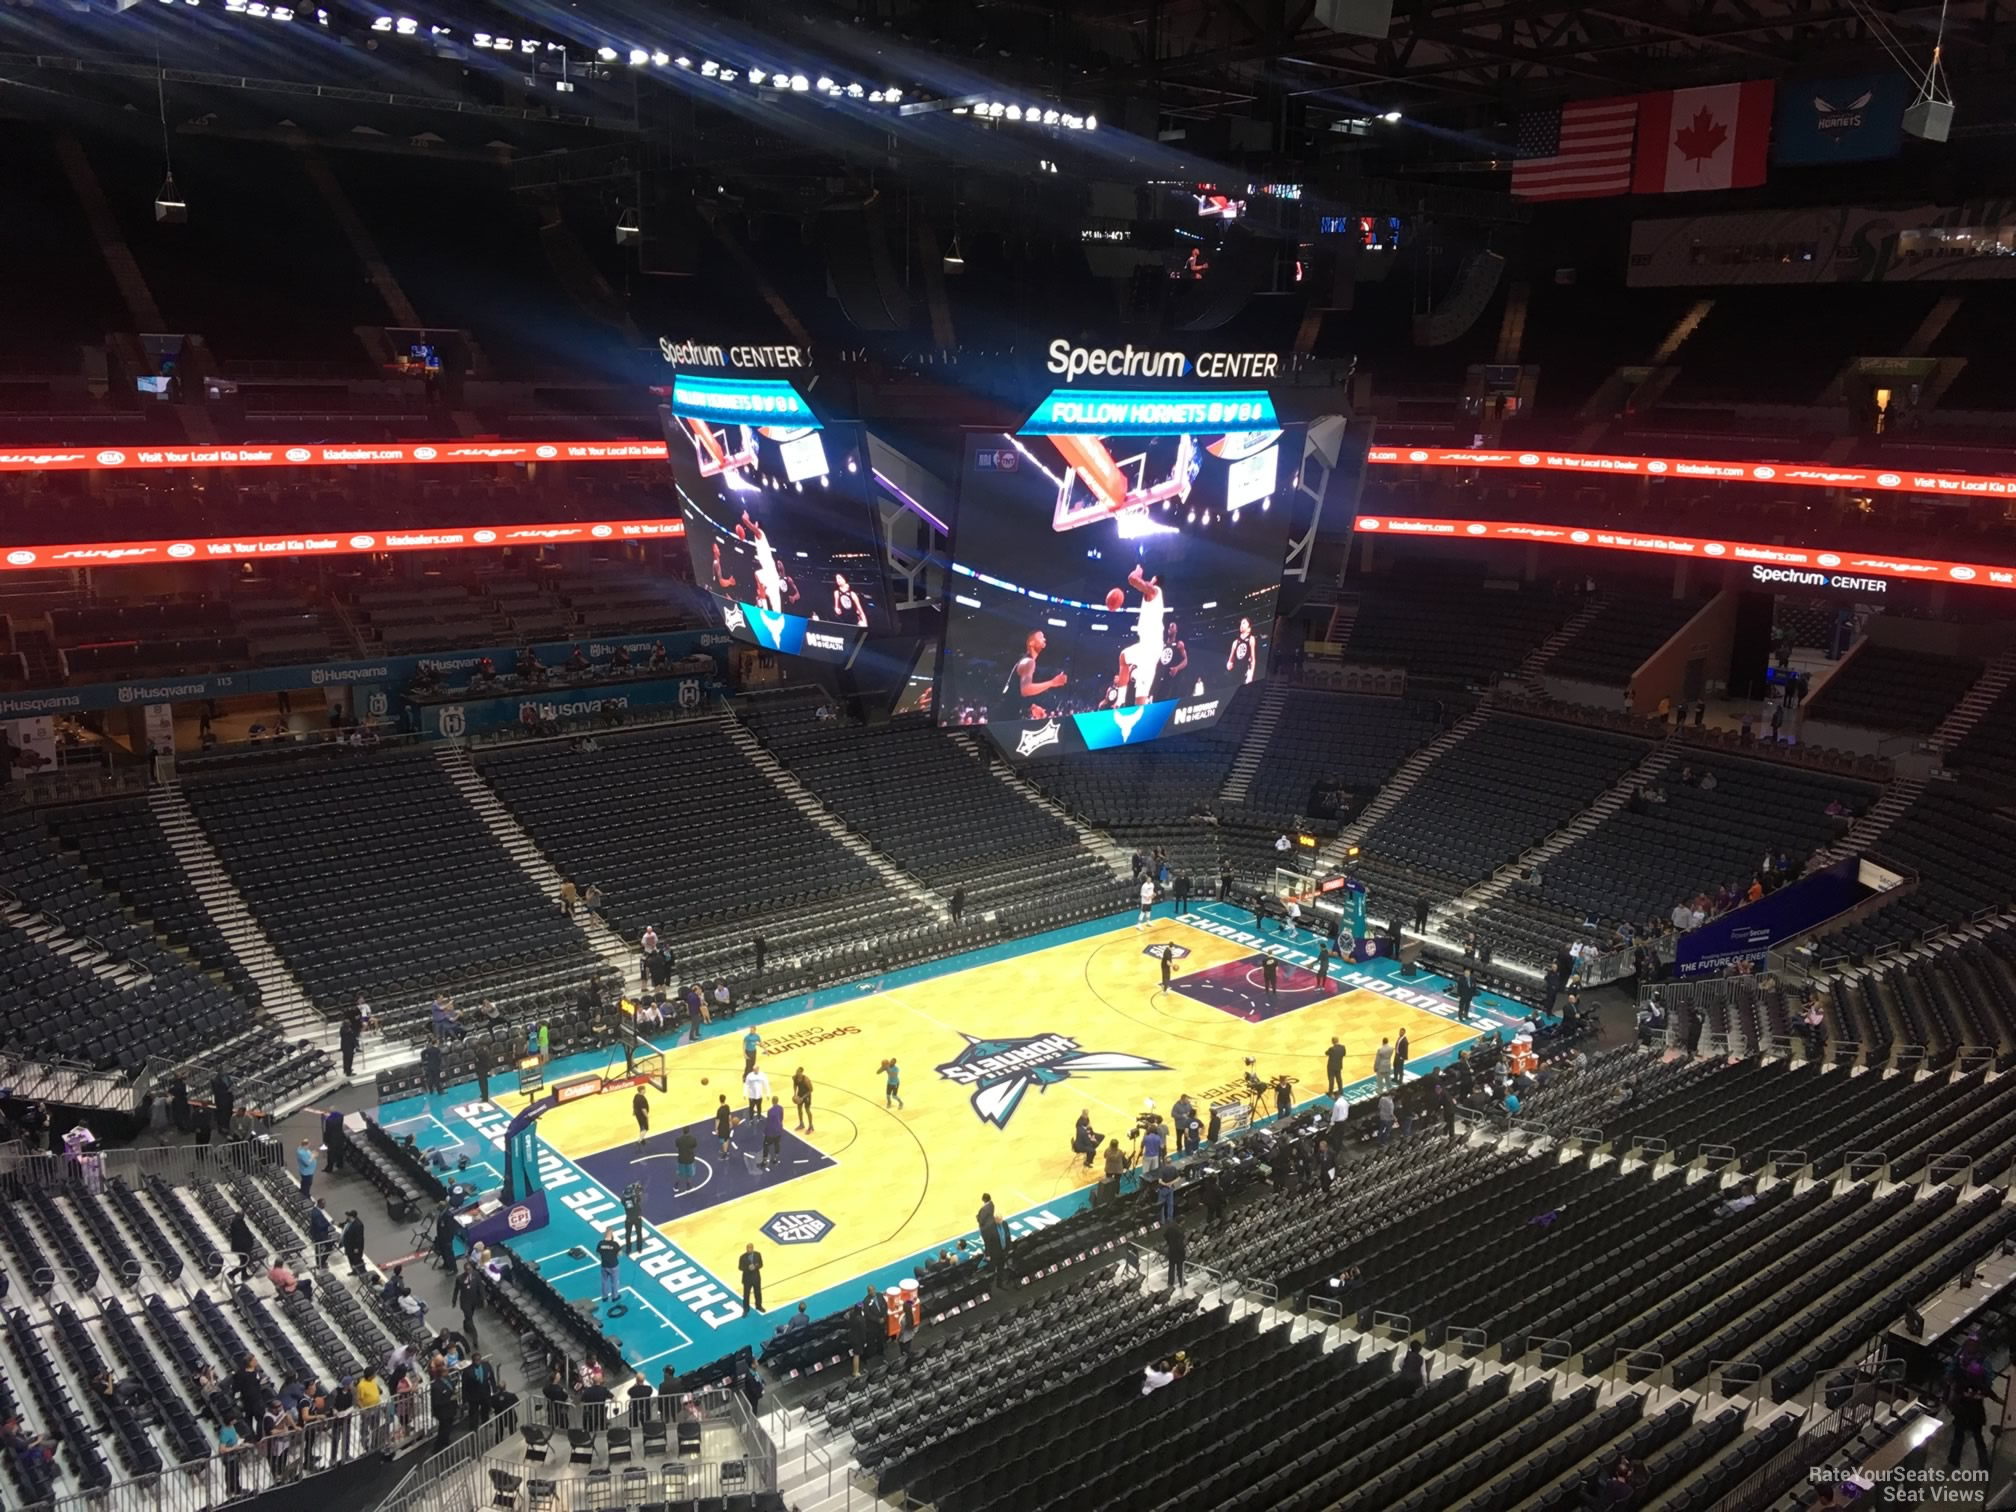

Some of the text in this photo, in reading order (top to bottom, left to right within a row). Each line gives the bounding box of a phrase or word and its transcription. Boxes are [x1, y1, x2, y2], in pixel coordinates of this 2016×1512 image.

[1817, 114, 1862, 130] HORNETS
[659, 337, 803, 368] Spectrum CENTER
[1047, 339, 1278, 382] Spectrum CENTER
[1052, 402, 1206, 423] FOLLOW HORNETS
[138, 449, 272, 463] Visit Your Local Kia Dealer
[568, 447, 587, 456] Visit
[588, 447, 606, 456] Your
[607, 446, 628, 455] Local
[1914, 478, 1937, 489] Visit
[1937, 479, 1960, 490] Your
[1961, 480, 1988, 492] Local
[1989, 482, 2006, 493] Kia
[207, 544, 232, 555] Visit
[233, 542, 258, 553] Your
[259, 540, 286, 552] Local
[1752, 565, 1887, 593] Spectrum CENTER
[325, 664, 388, 681] Husqvarna
[431, 657, 484, 672] Husqvarn
[133, 683, 205, 700] Husqvarna
[1681, 962, 1697, 973] THE
[1698, 957, 1730, 969] FUTURE
[942, 1034, 1078, 1084] HORNETS
[510, 1211, 529, 1224] CPI
[771, 1214, 815, 1233] CITY
[777, 1219, 826, 1241] BUZZ
